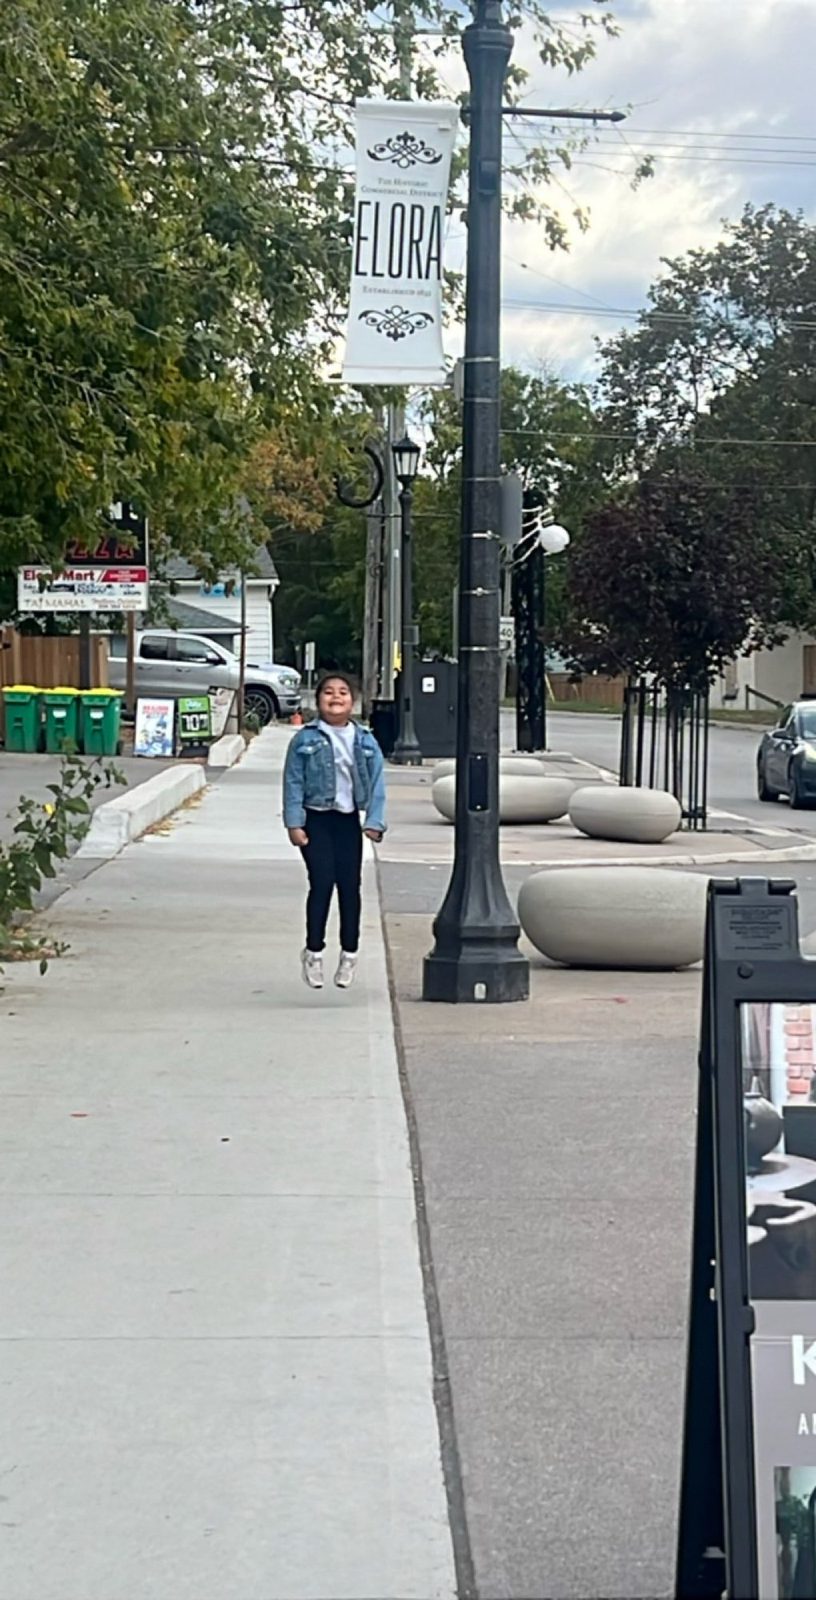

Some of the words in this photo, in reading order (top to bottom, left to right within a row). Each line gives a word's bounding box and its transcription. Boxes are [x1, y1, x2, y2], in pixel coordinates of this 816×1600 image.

[355, 201, 442, 281] ELORA
[63, 569, 95, 581] Mart
[500, 628, 513, 638] 40
